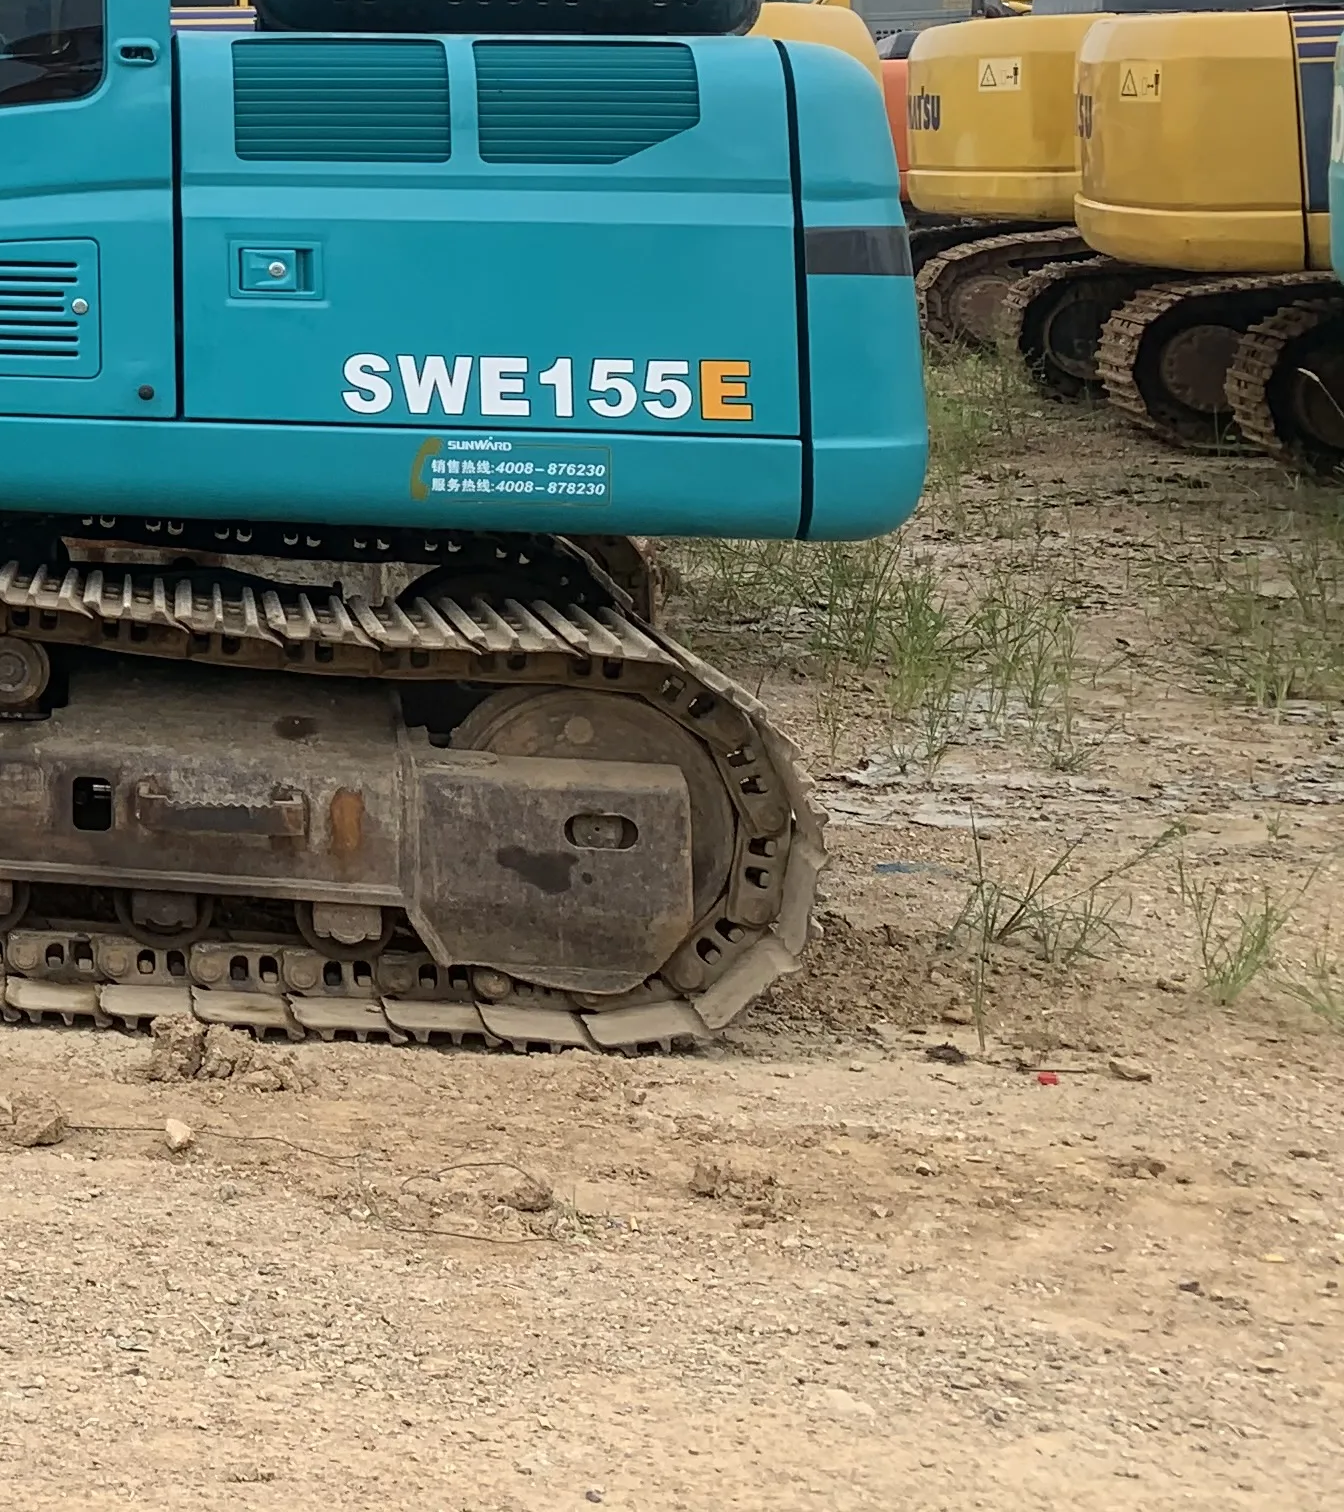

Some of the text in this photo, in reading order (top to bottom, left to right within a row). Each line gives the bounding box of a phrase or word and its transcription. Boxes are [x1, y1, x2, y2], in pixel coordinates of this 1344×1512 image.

[908, 86, 941, 131] ATSU
[340, 352, 754, 421] SWE155E
[447, 436, 512, 452] SUNWARD
